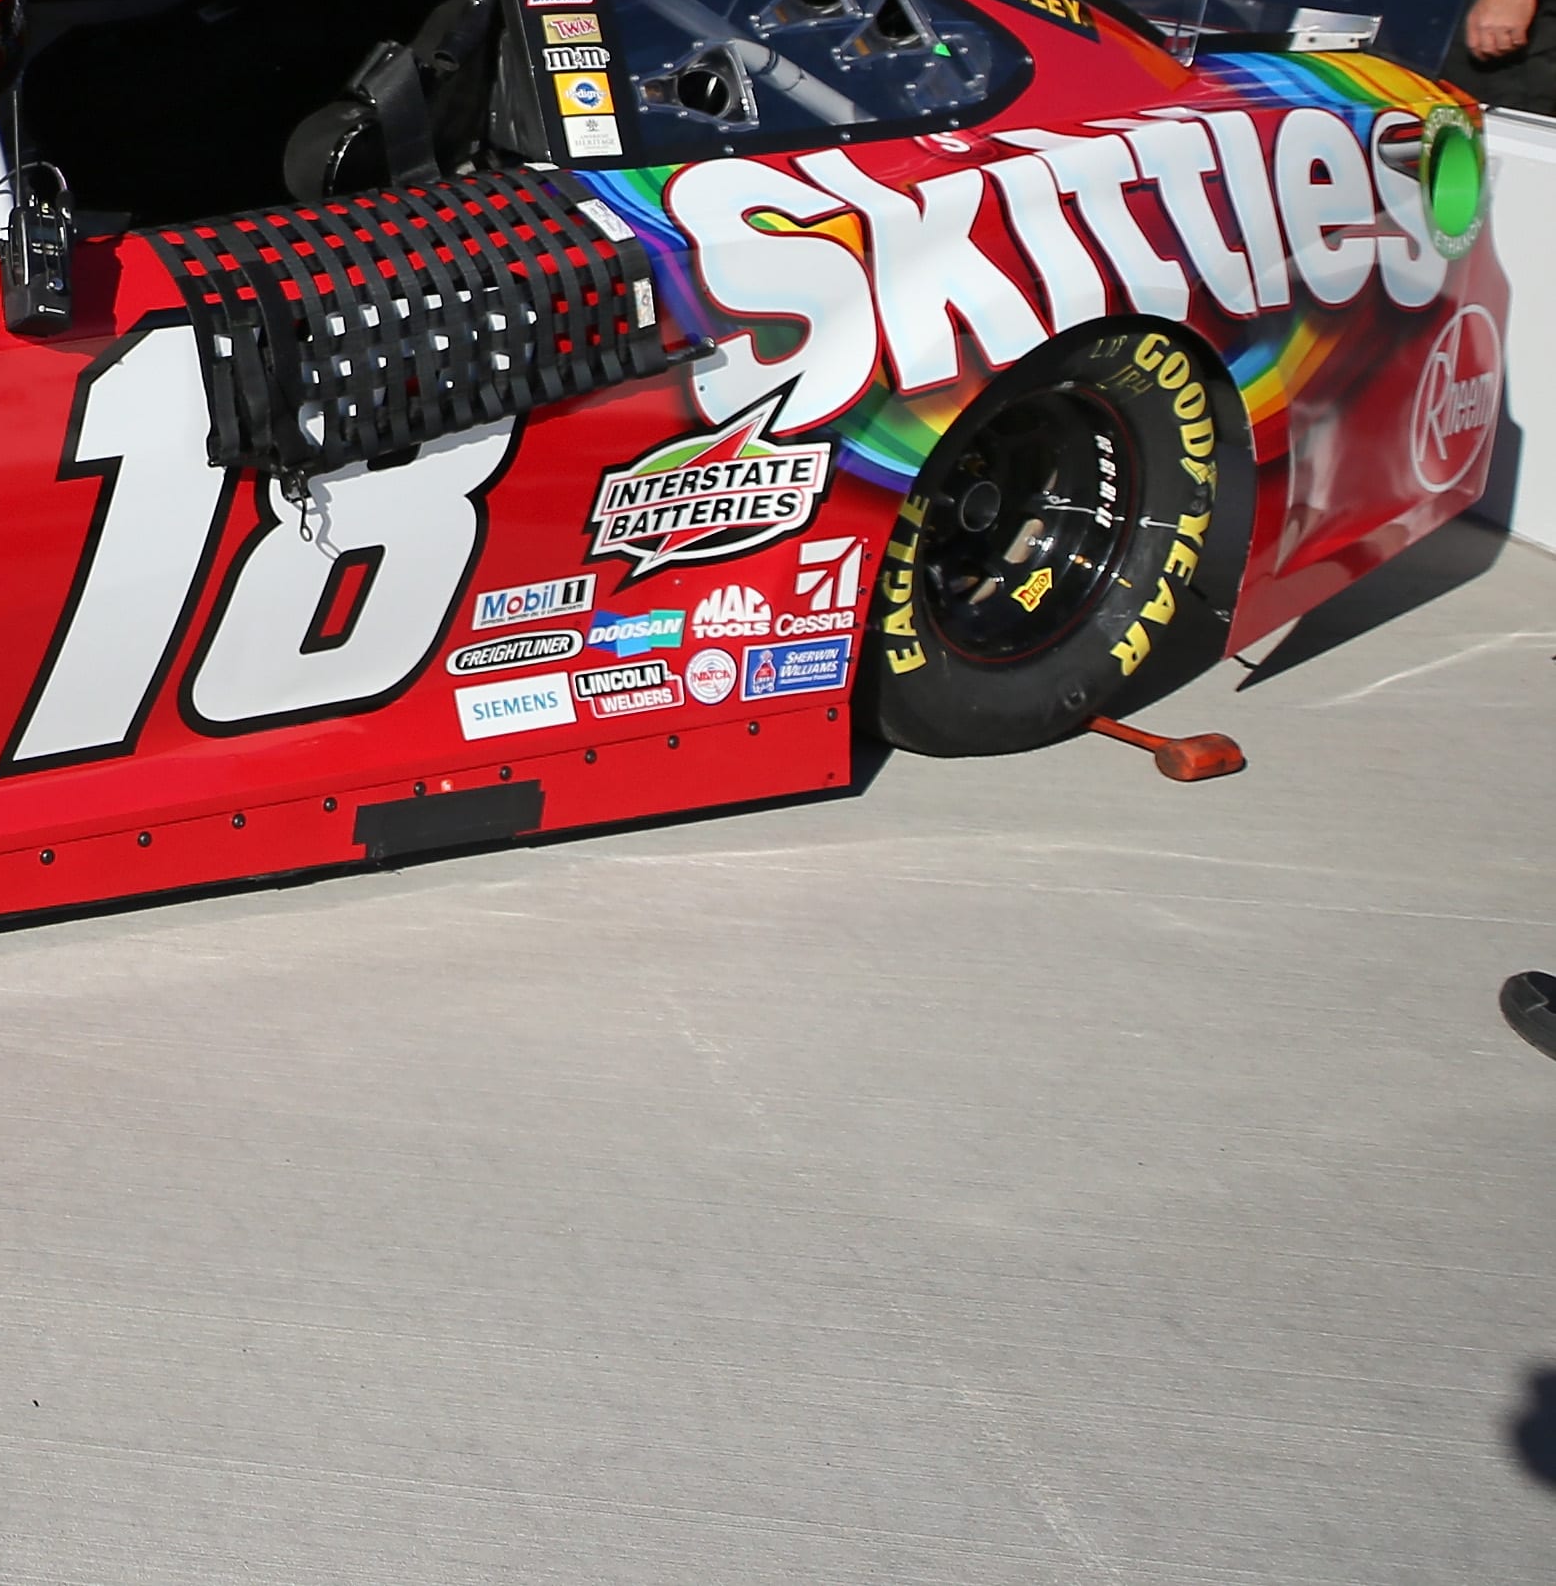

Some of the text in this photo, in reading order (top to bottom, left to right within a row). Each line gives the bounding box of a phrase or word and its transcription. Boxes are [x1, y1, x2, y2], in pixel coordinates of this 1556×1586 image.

[664, 106, 1450, 430] Skittles
[1416, 312, 1494, 462] Rheem
[607, 457, 814, 509] INTERSTATE
[607, 491, 800, 541] BATTERIES
[884, 493, 931, 676] EAGLE
[1021, 574, 1051, 606] AERO
[481, 583, 557, 620] Mobil
[692, 584, 772, 625] MAC
[588, 615, 684, 645] DOOSAN
[690, 619, 771, 638] TOOLS
[774, 610, 856, 637] Cessna
[459, 636, 572, 668] FREIGHTLINER
[784, 648, 839, 664] SHERWIN
[576, 665, 663, 697] LINCOLN
[691, 670, 733, 683] NATCA
[779, 661, 838, 678] WILLIAMS
[472, 690, 559, 721] SIEMENS
[599, 688, 674, 713] WELDERS
